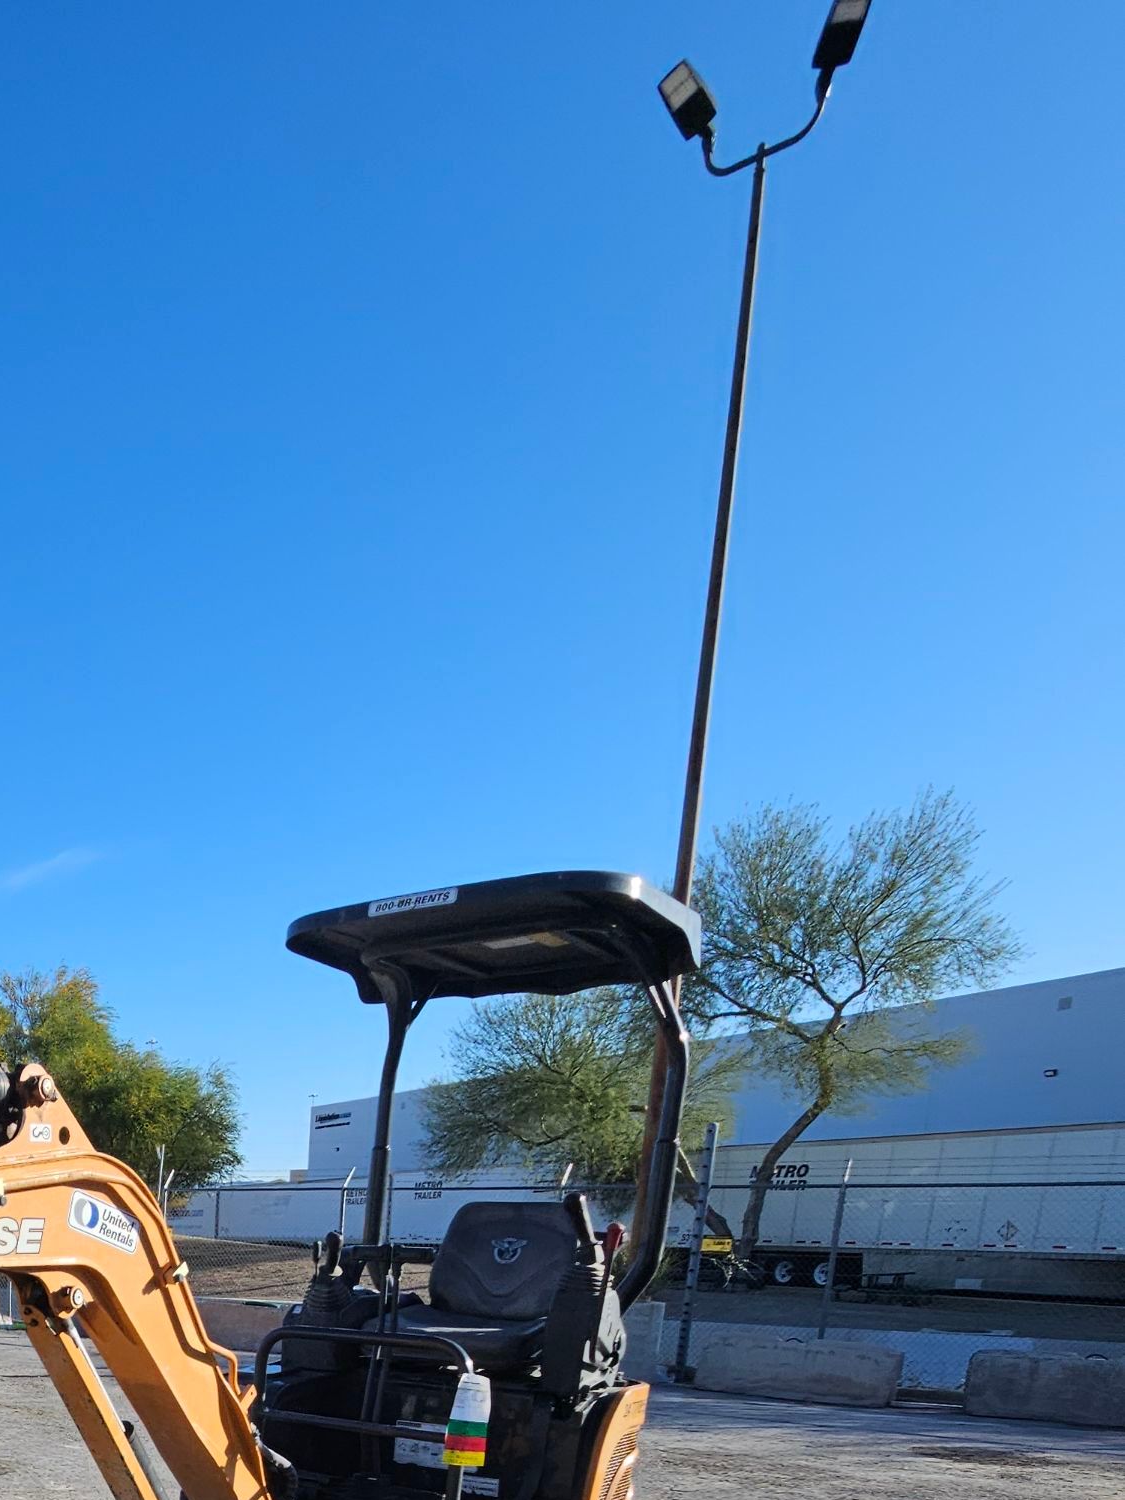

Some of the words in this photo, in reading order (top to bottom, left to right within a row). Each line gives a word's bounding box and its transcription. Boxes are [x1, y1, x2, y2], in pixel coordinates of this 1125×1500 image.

[414, 1191, 442, 1200] TRAILER
[102, 1208, 135, 1233] United
[98, 1222, 134, 1247] Rentals
